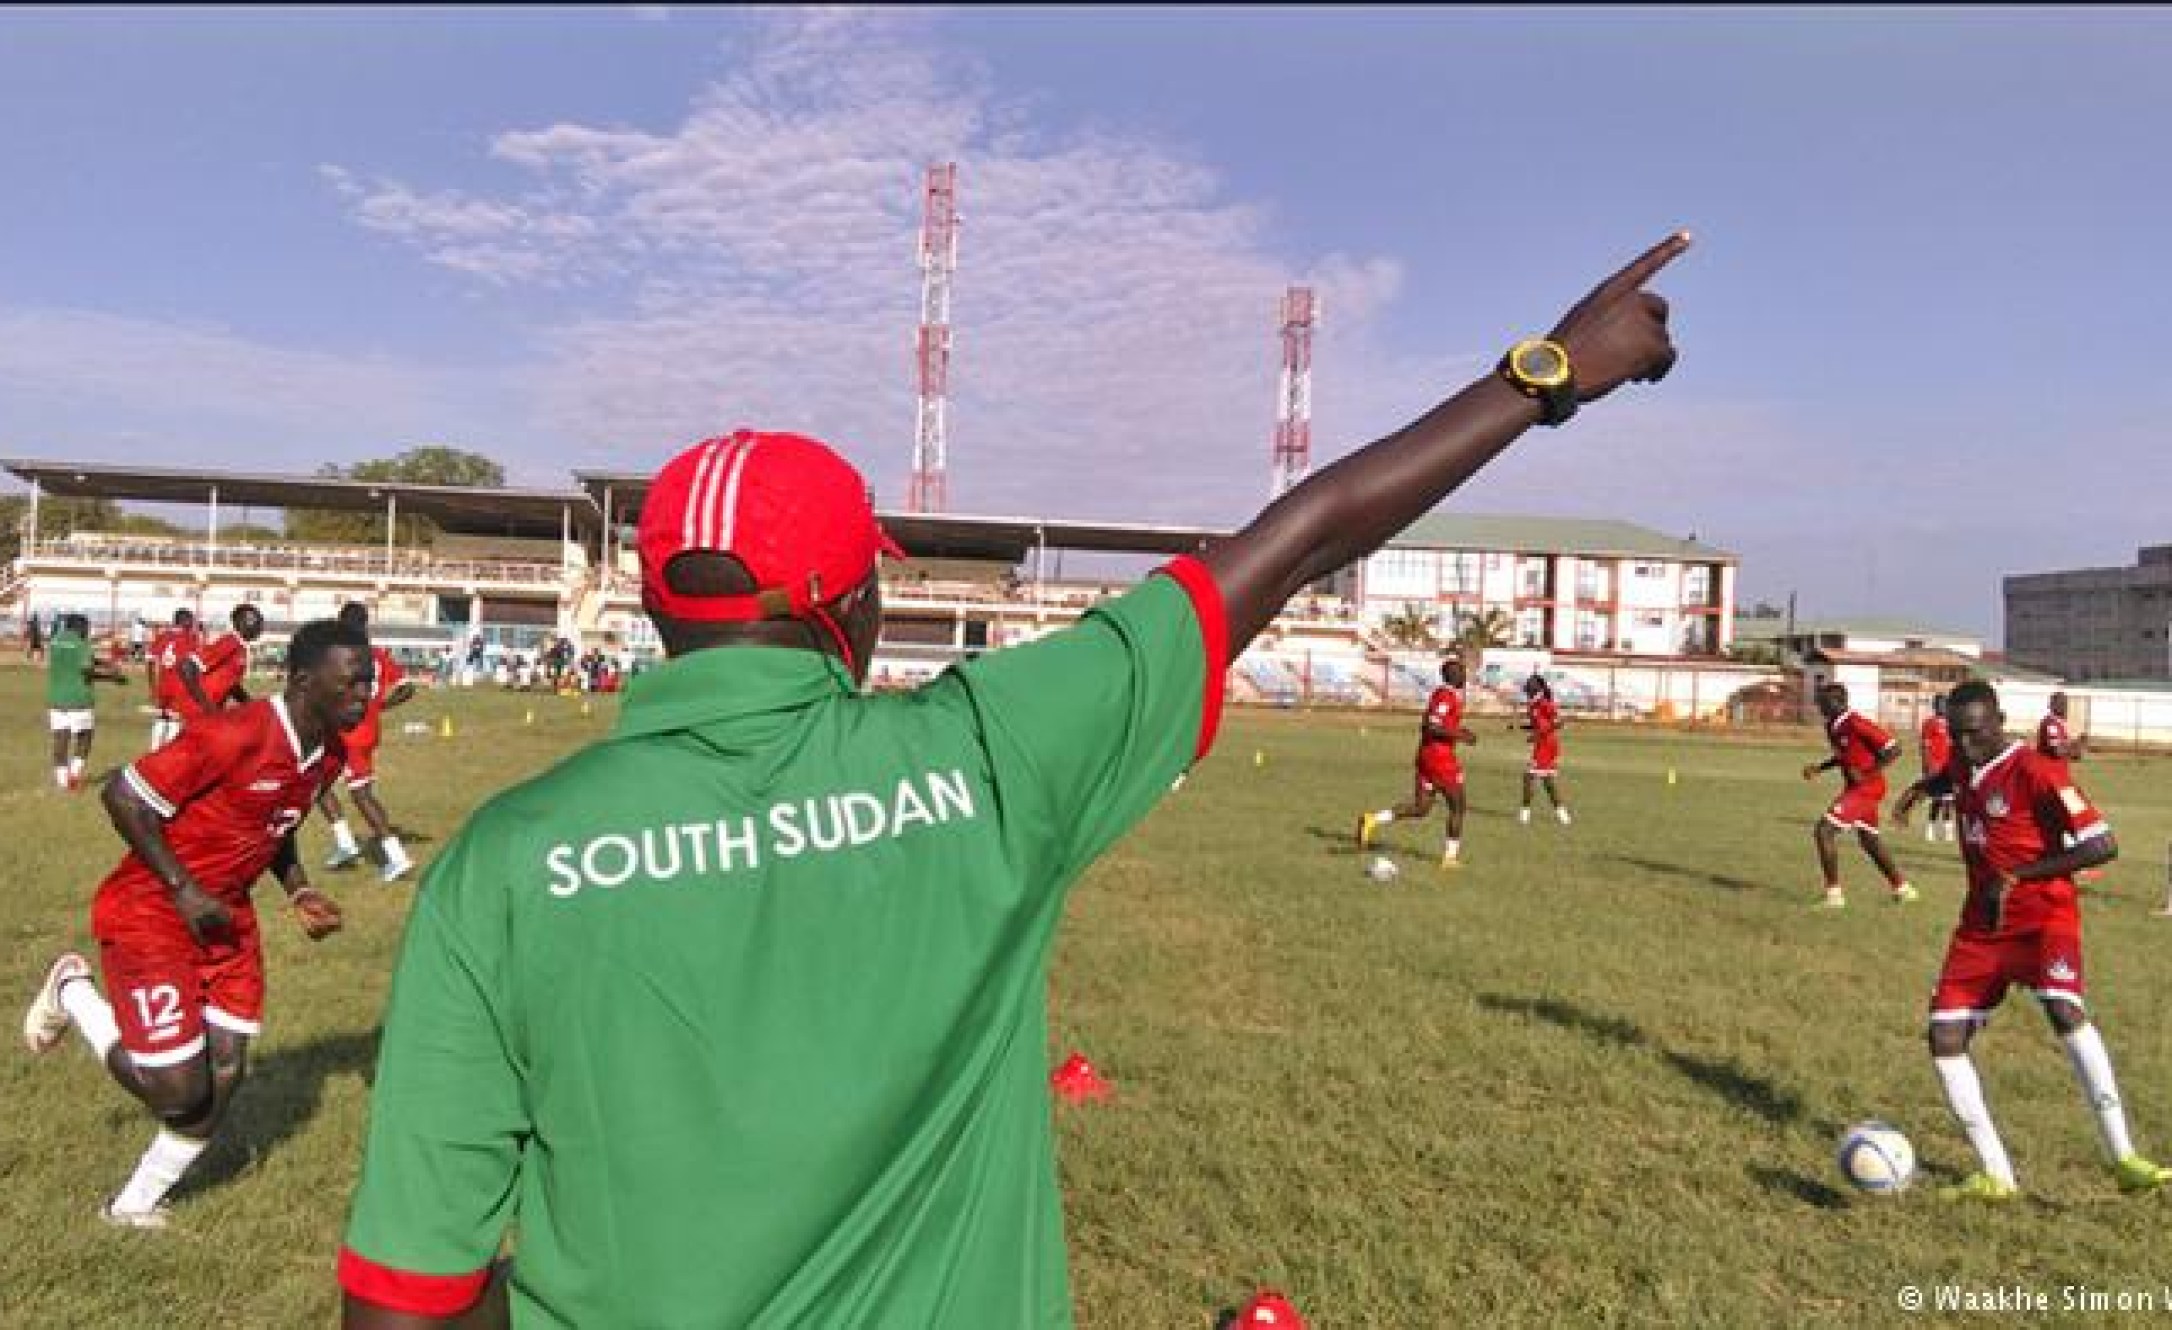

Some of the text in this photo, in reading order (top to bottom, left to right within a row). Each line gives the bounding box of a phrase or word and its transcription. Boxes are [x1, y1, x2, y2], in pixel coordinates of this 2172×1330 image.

[546, 769, 976, 897] SOUTH SUDAN
[131, 984, 187, 1027] 12
